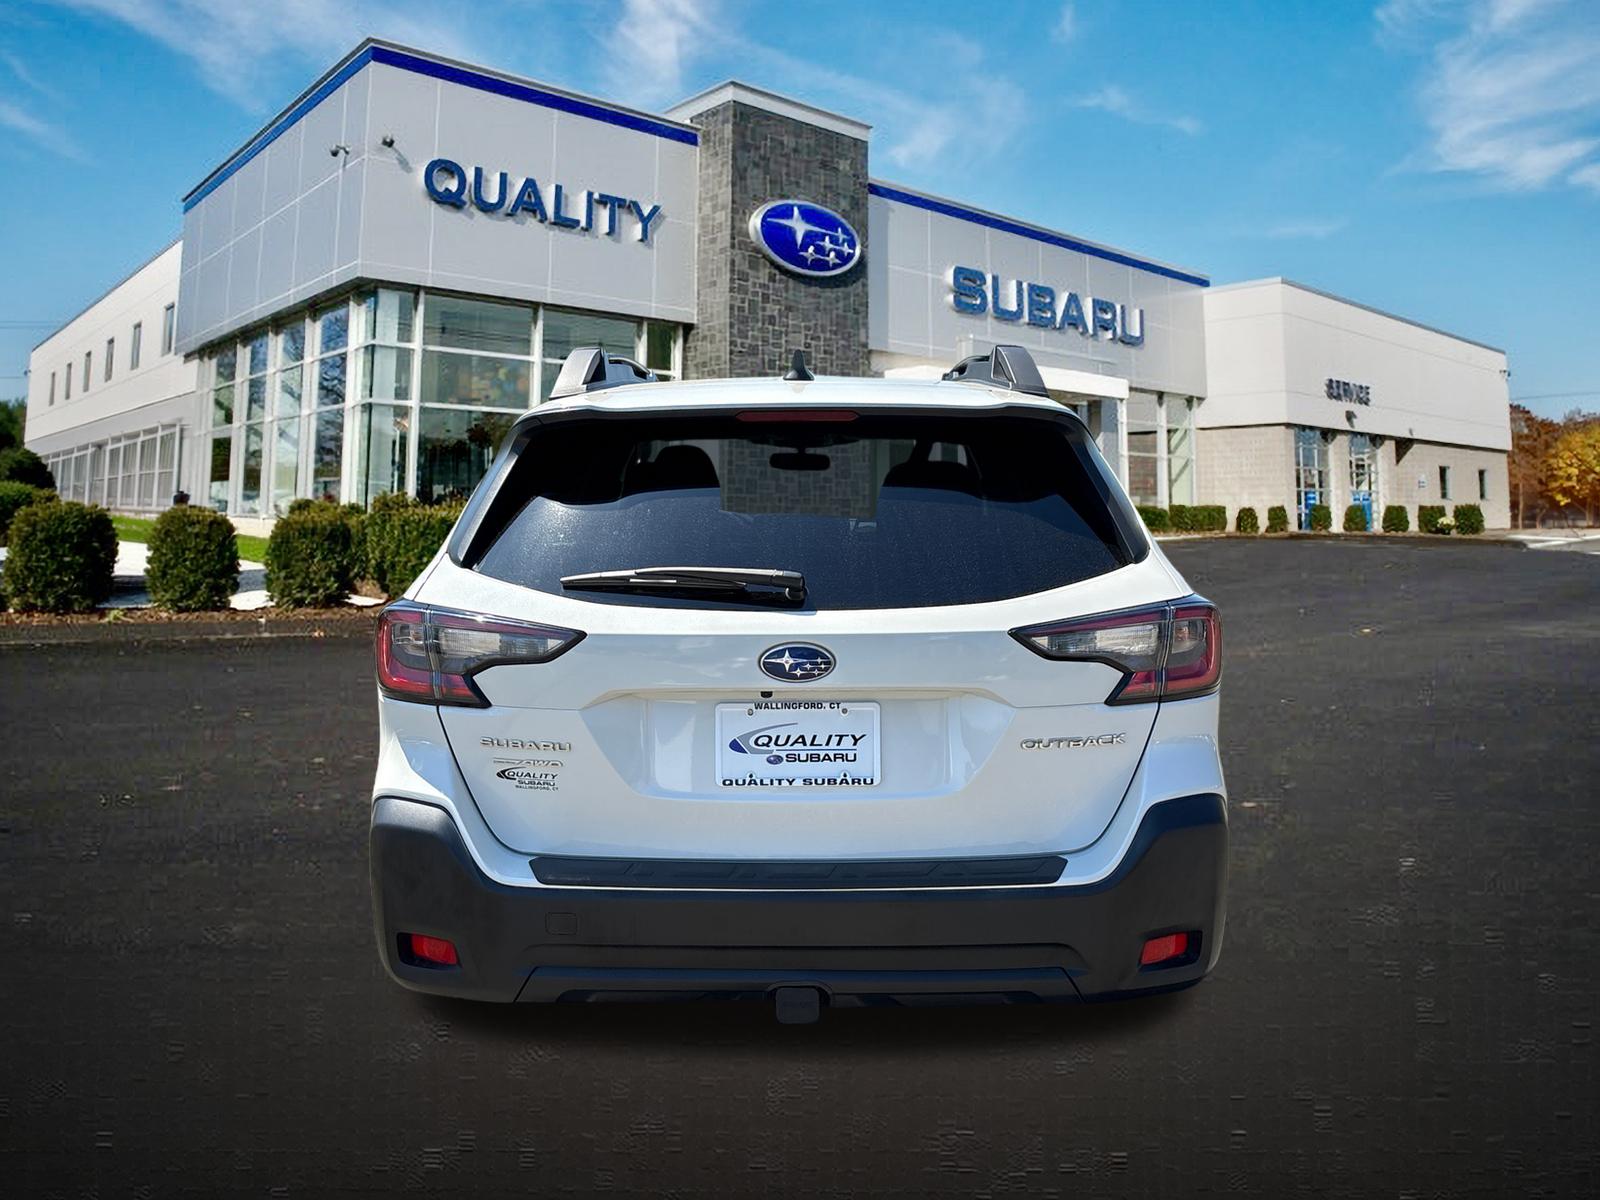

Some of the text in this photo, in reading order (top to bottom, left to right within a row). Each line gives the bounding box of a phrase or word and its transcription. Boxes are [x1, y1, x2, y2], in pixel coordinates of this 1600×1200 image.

[424, 158, 662, 243] QUALITY
[953, 266, 1144, 346] SUBARU
[1325, 378, 1371, 407] SERVICE
[829, 702, 841, 710] CT
[480, 736, 572, 751] SUBARU
[753, 734, 866, 747] QUALITY
[1020, 732, 1127, 750] OUTBACK
[785, 753, 857, 763] SUBARU
[507, 771, 558, 779] QUALITY
[722, 778, 875, 787] QUALITY SUBARU
